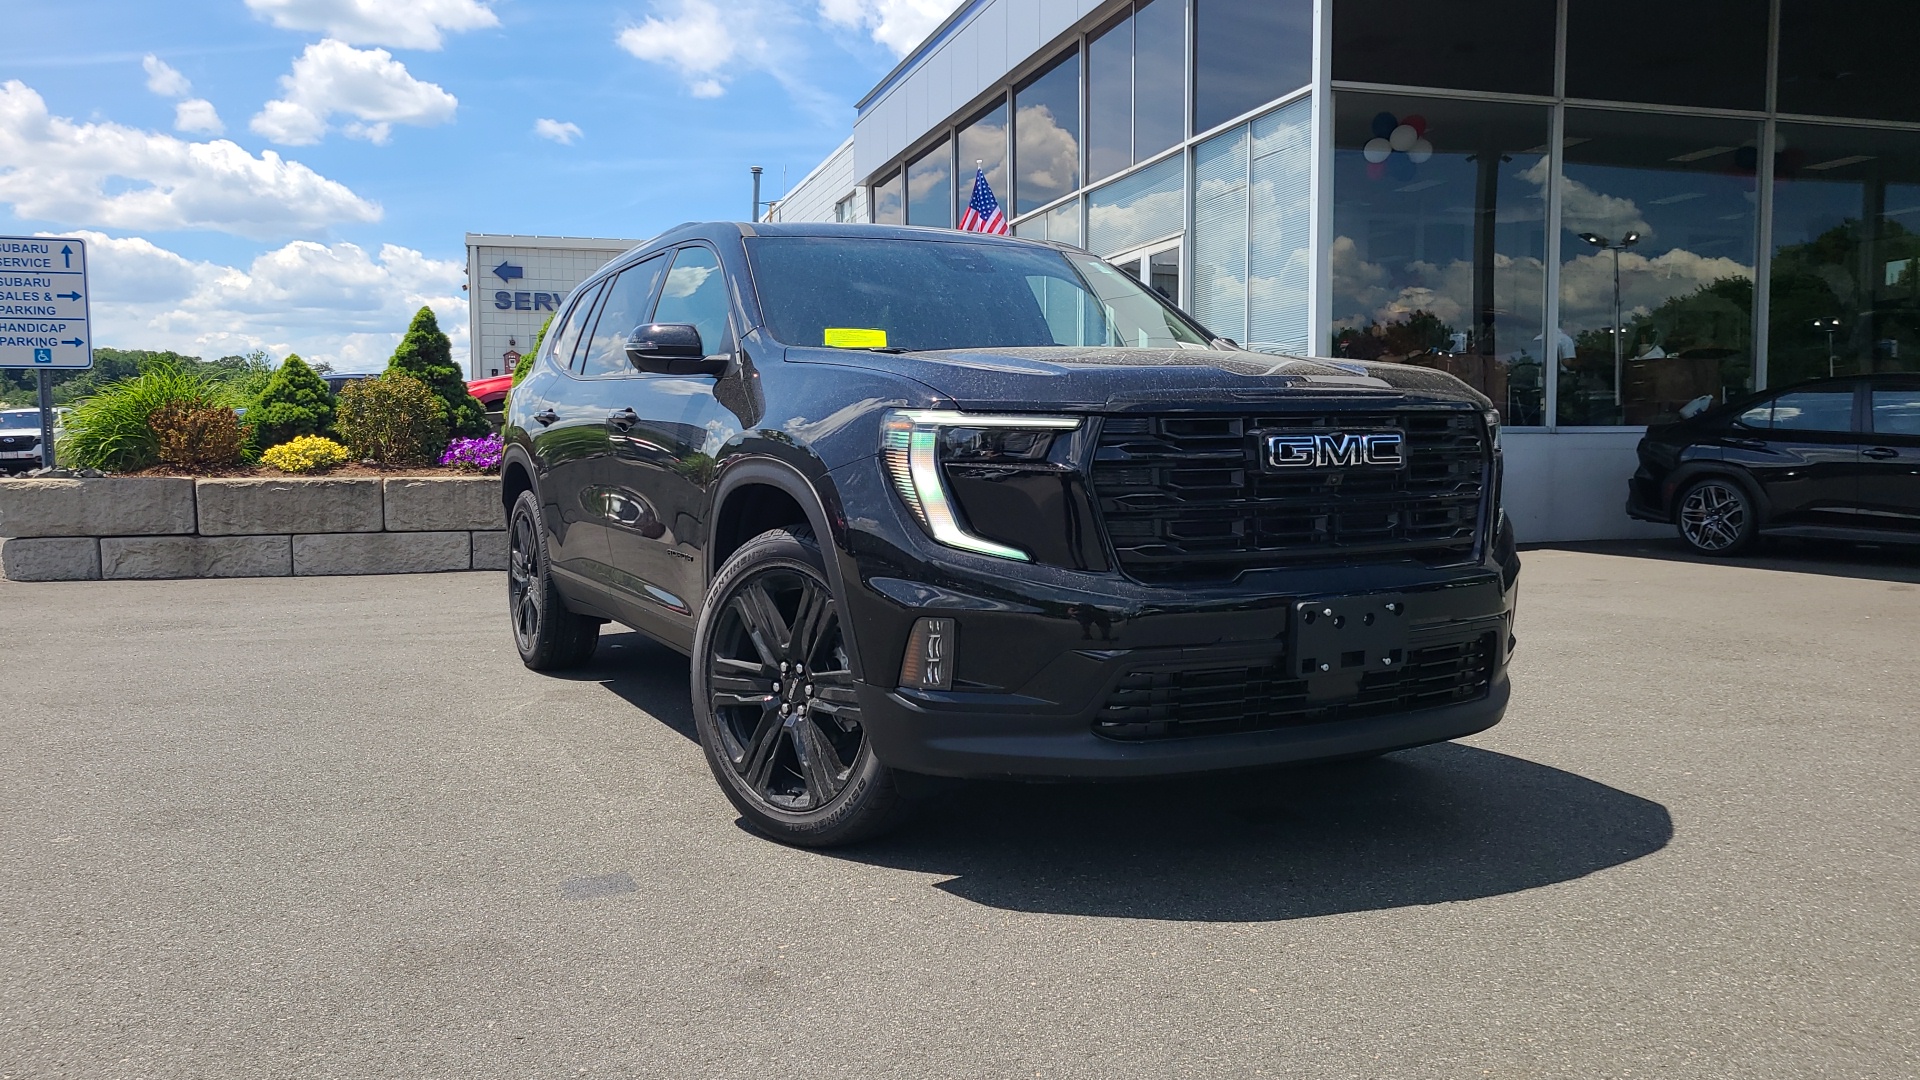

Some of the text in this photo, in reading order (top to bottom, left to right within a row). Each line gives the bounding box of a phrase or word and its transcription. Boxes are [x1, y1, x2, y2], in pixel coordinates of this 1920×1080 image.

[0, 243, 49, 254] UBARU
[43, 292, 53, 302] &
[0, 322, 67, 333] HANDICAP
[0, 337, 58, 347] PARKING
[1268, 434, 1402, 467] GMC
